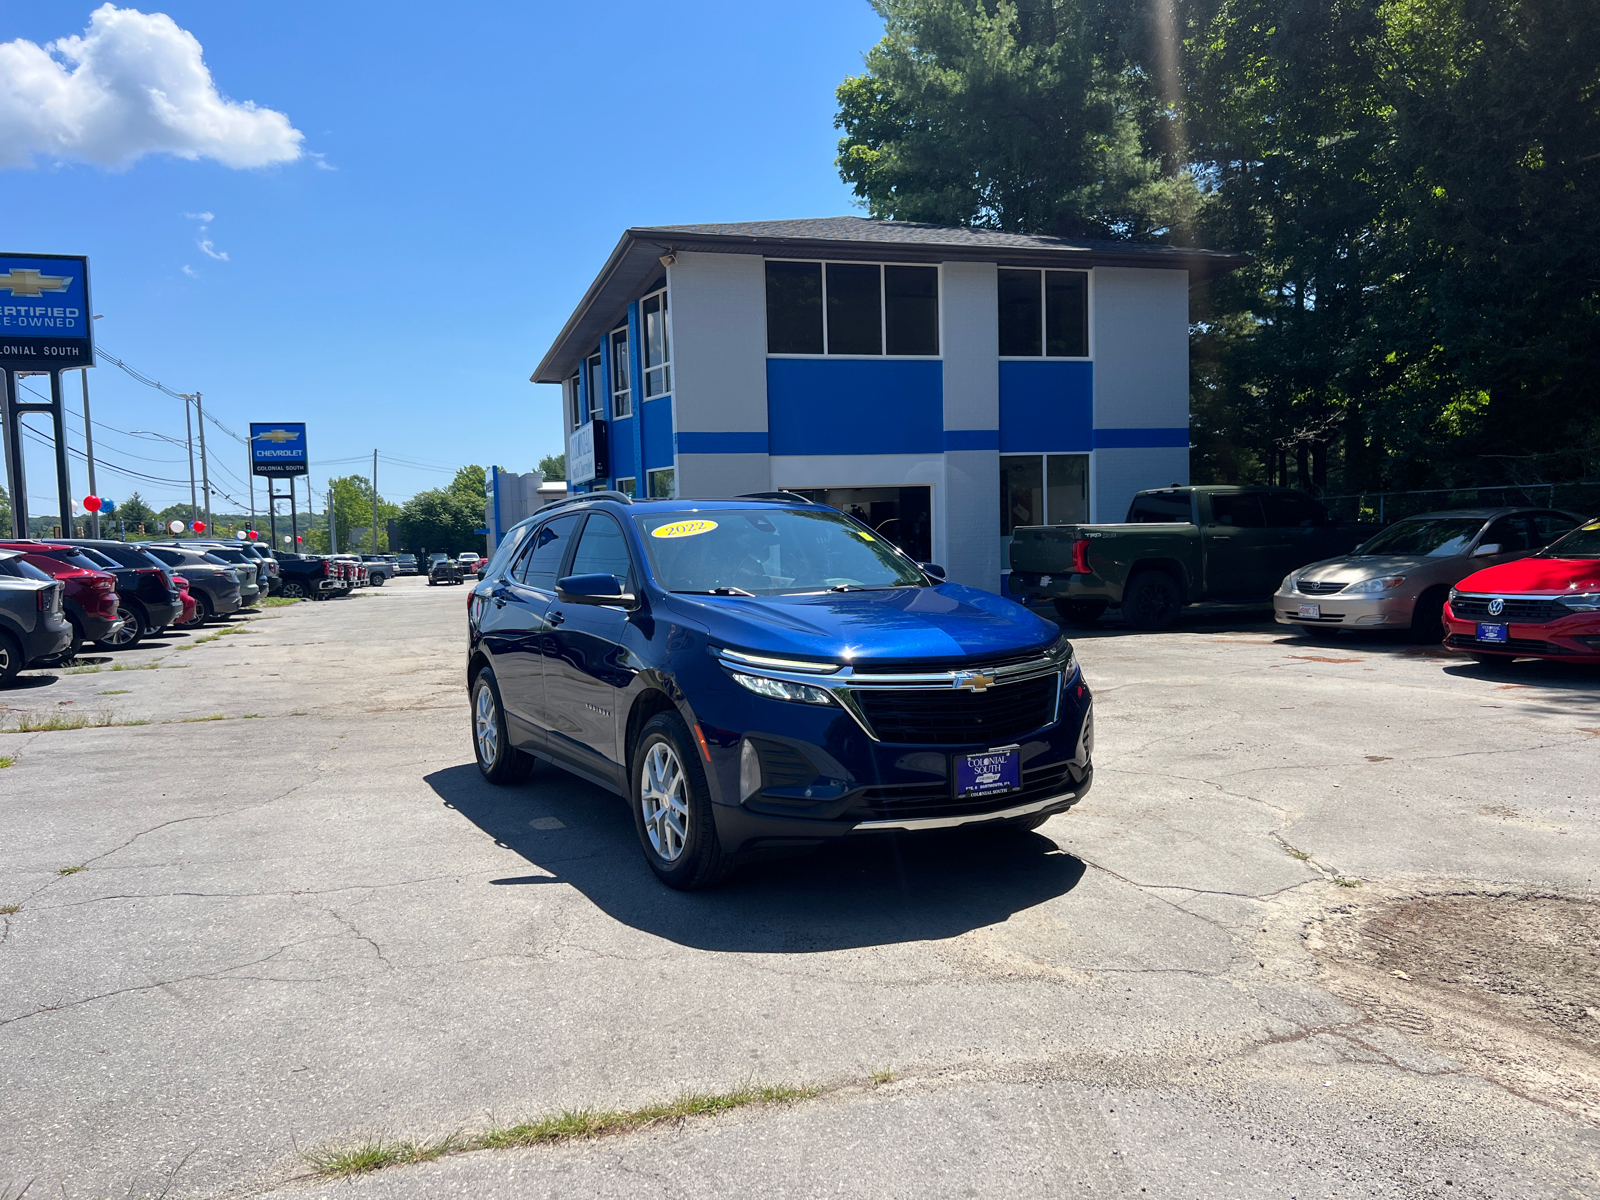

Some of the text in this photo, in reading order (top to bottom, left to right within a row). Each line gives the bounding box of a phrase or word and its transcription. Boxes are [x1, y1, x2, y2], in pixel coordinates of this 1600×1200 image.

[0, 306, 79, 317] RTIFIED
[0, 316, 75, 328] E-OWNED
[43, 346, 79, 356] SOUTH
[665, 521, 707, 536] 2022
[967, 756, 1007, 767] COLONIAL
[974, 764, 1001, 775] SOUTH
